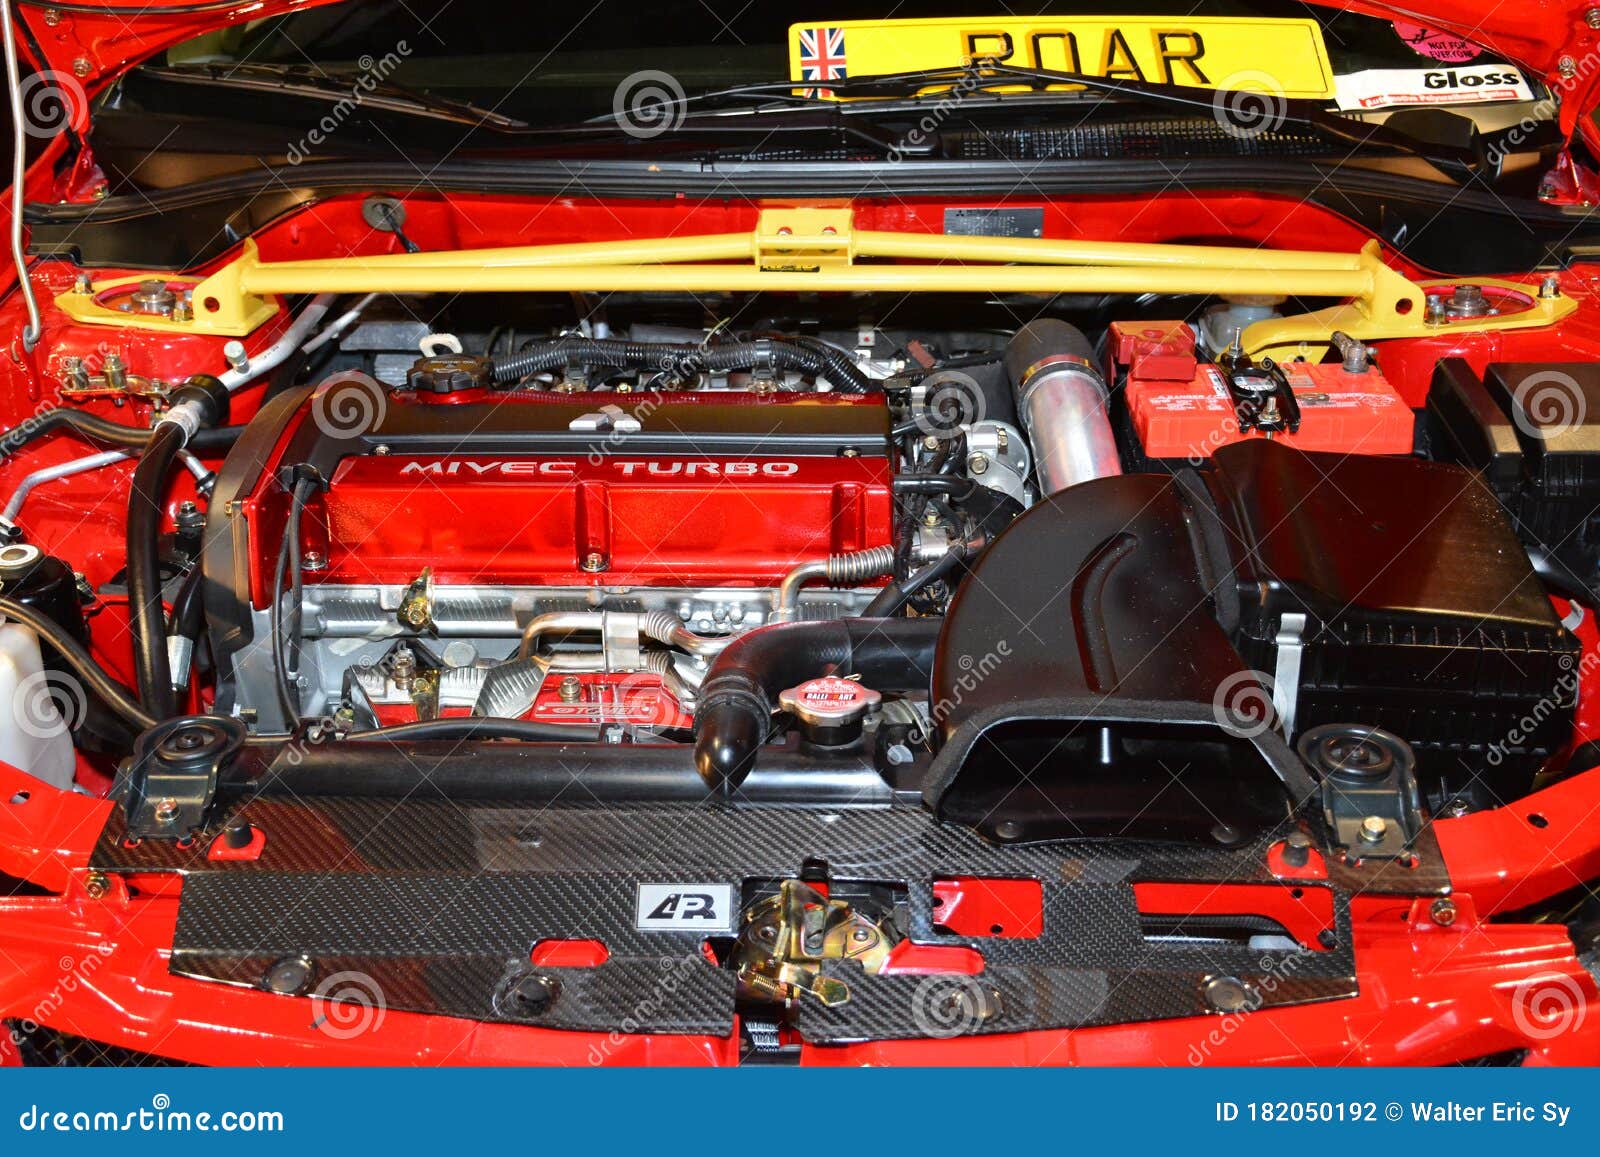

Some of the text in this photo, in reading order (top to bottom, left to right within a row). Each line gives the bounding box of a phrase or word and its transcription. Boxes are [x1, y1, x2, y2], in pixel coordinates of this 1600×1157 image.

[960, 28, 1211, 85] ROAR
[1424, 71, 1520, 89] Gloss
[400, 461, 800, 476] MIVEC TURBO
